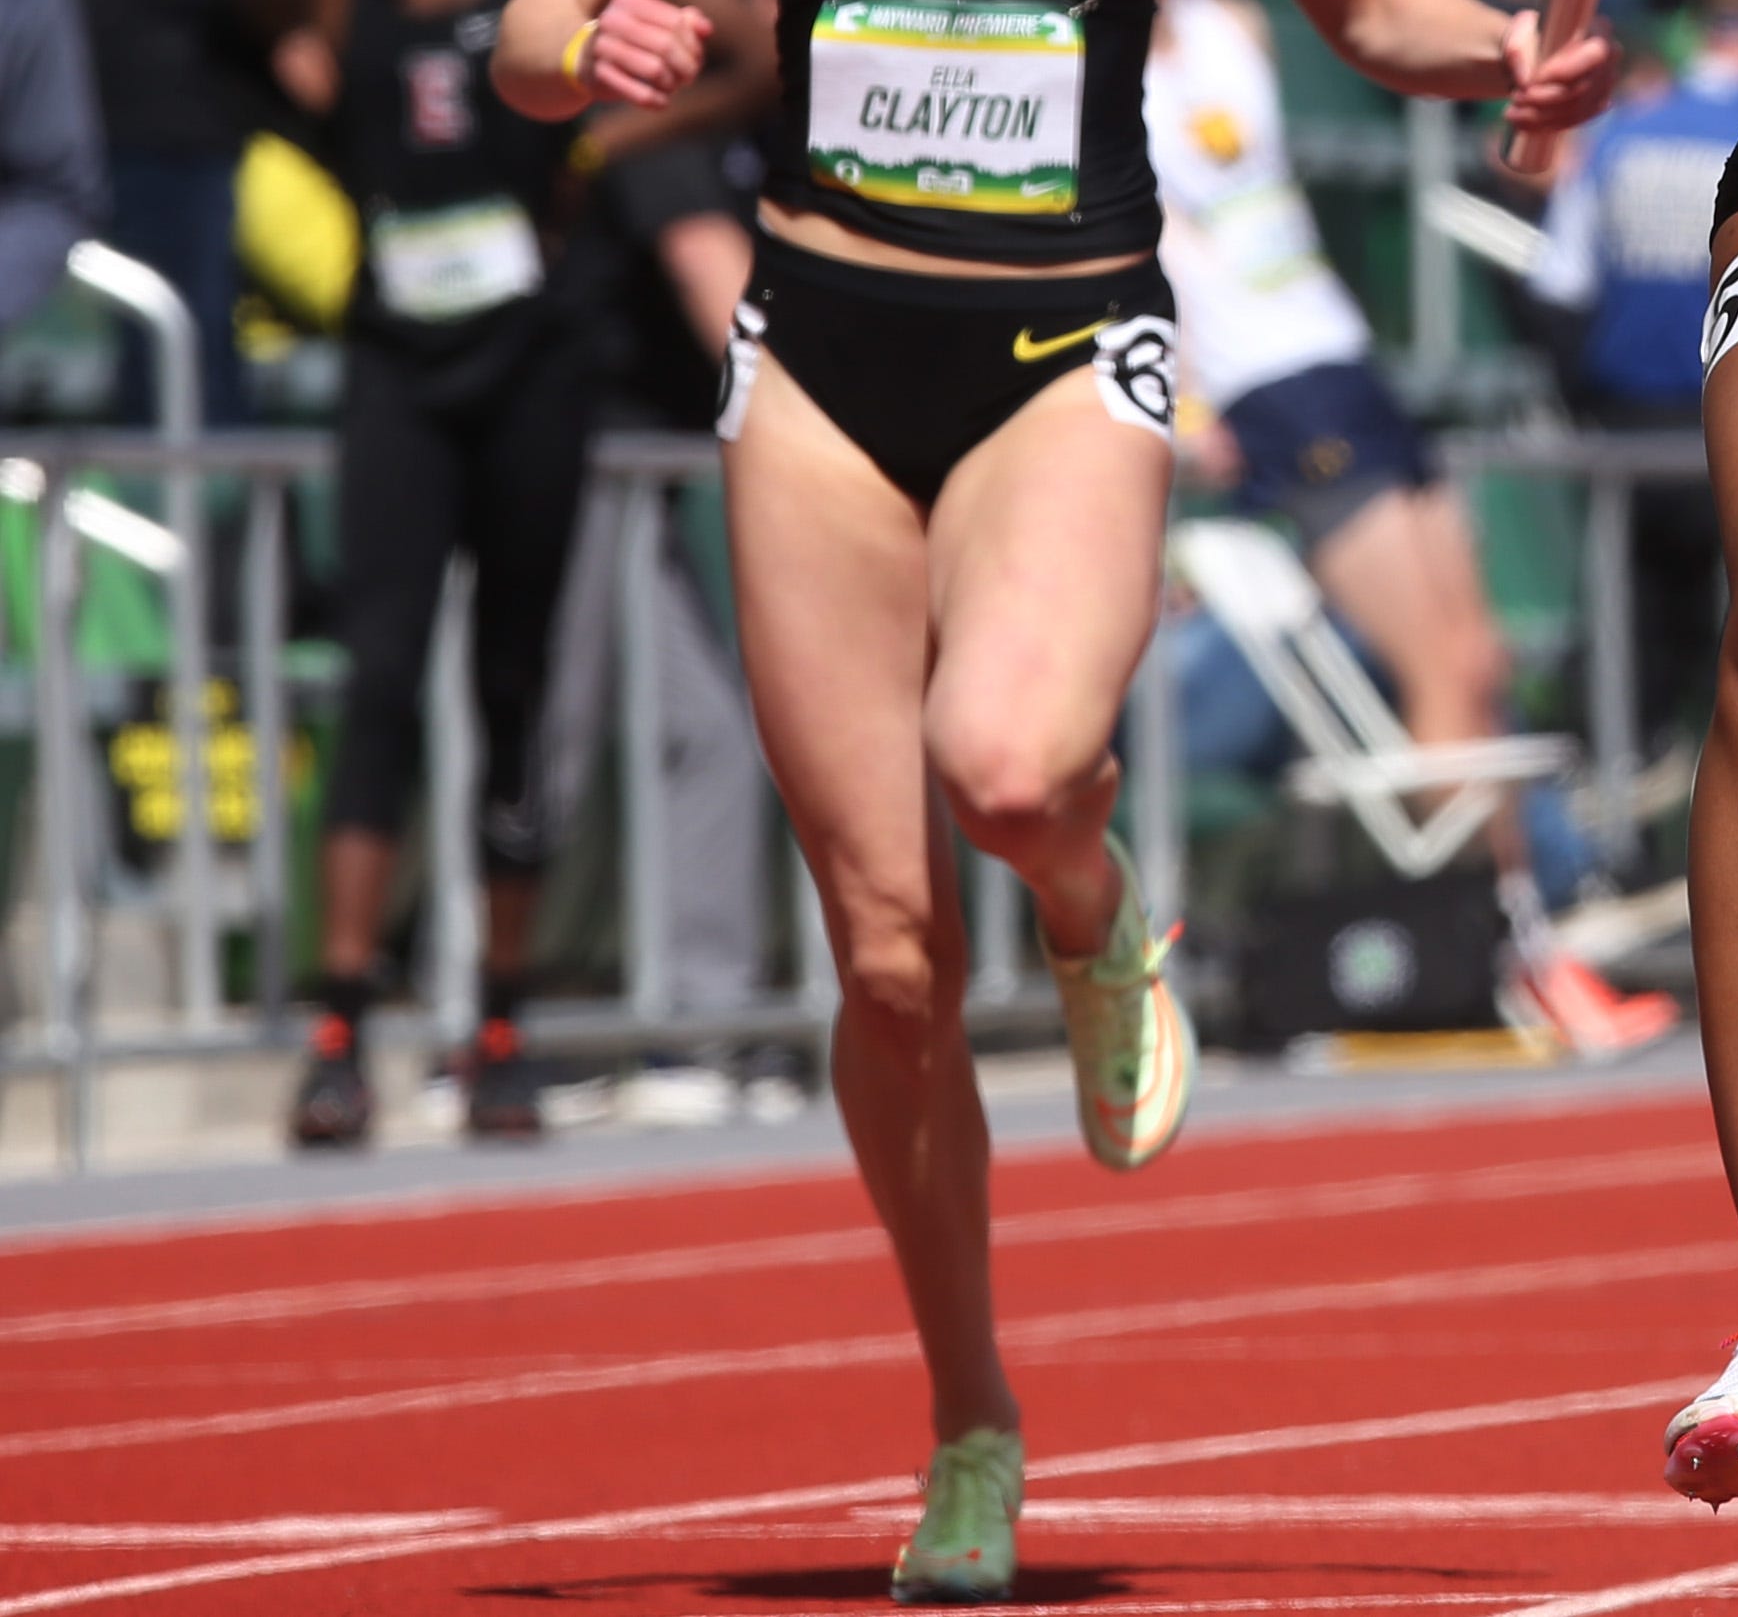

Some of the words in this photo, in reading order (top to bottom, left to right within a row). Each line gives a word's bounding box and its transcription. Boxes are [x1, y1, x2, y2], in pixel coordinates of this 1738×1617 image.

[867, 4, 952, 33] HAYWARD
[952, 13, 1041, 37] PREMIERE
[930, 65, 976, 89] ELLA
[859, 85, 1042, 141] CLAYTON
